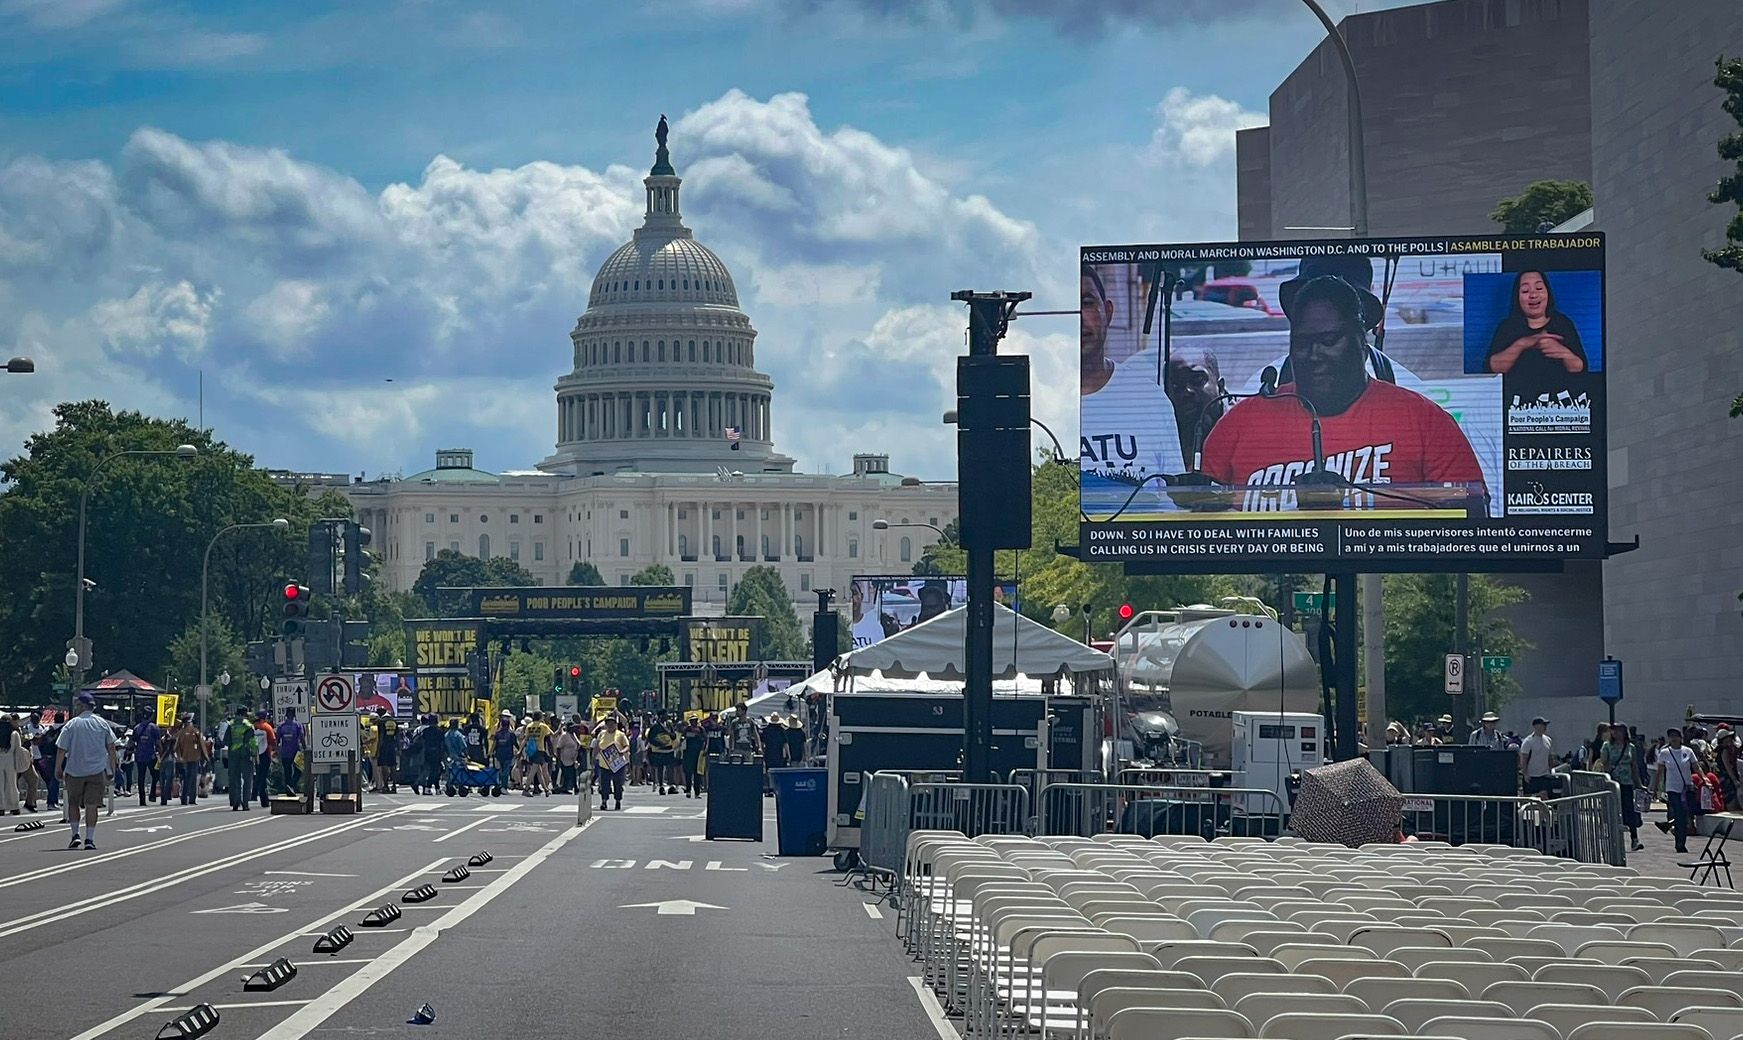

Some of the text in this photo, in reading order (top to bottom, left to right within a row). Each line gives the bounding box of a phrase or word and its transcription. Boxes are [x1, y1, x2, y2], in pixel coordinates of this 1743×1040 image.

[1082, 237, 1601, 262] ASSEMBLY AND MORAL MARCH ON WASHINGTON D.C. AND TO THE POLLS ASAMBLEA DE TRABAJADOR
[1509, 415, 1589, 424] Poor People's Campaign
[1508, 447, 1592, 460] REPAIRERS
[1509, 461, 1591, 469] OF THE BREACH
[1243, 444, 1393, 511] ORGNIZE
[1550, 492, 1594, 505] CENTER
[1090, 528, 1319, 540] DOWN. SO I HAVE TO DEAL WITH FAMILIES
[1345, 527, 1592, 538] Uno de mis supervisores intentó convencerme
[1090, 543, 1324, 555] CALLING US IN CRISIS EVERY DAY OR BEING
[1345, 544, 1351, 552] a
[1369, 544, 1376, 554] y
[1377, 544, 1384, 552] a
[1386, 542, 1406, 552] mis
[1408, 542, 1476, 554] trabajadores
[1478, 543, 1499, 553] que
[1501, 543, 1511, 552] el
[1513, 542, 1555, 552] unirnos
[1557, 544, 1564, 552] a
[1566, 544, 1580, 552] un
[526, 596, 637, 609] POOR PEOPLE'S CAMPAIGN
[416, 630, 477, 642] WE WON'T BE
[690, 628, 704, 640] WE
[738, 628, 750, 640] BE
[690, 640, 749, 663] SILENT
[417, 677, 433, 689] WE
[436, 677, 455, 689] ARE
[1189, 709, 1233, 719] POTABLE
[320, 719, 349, 728] TURNING
[313, 750, 349, 759] USE X-WAL
